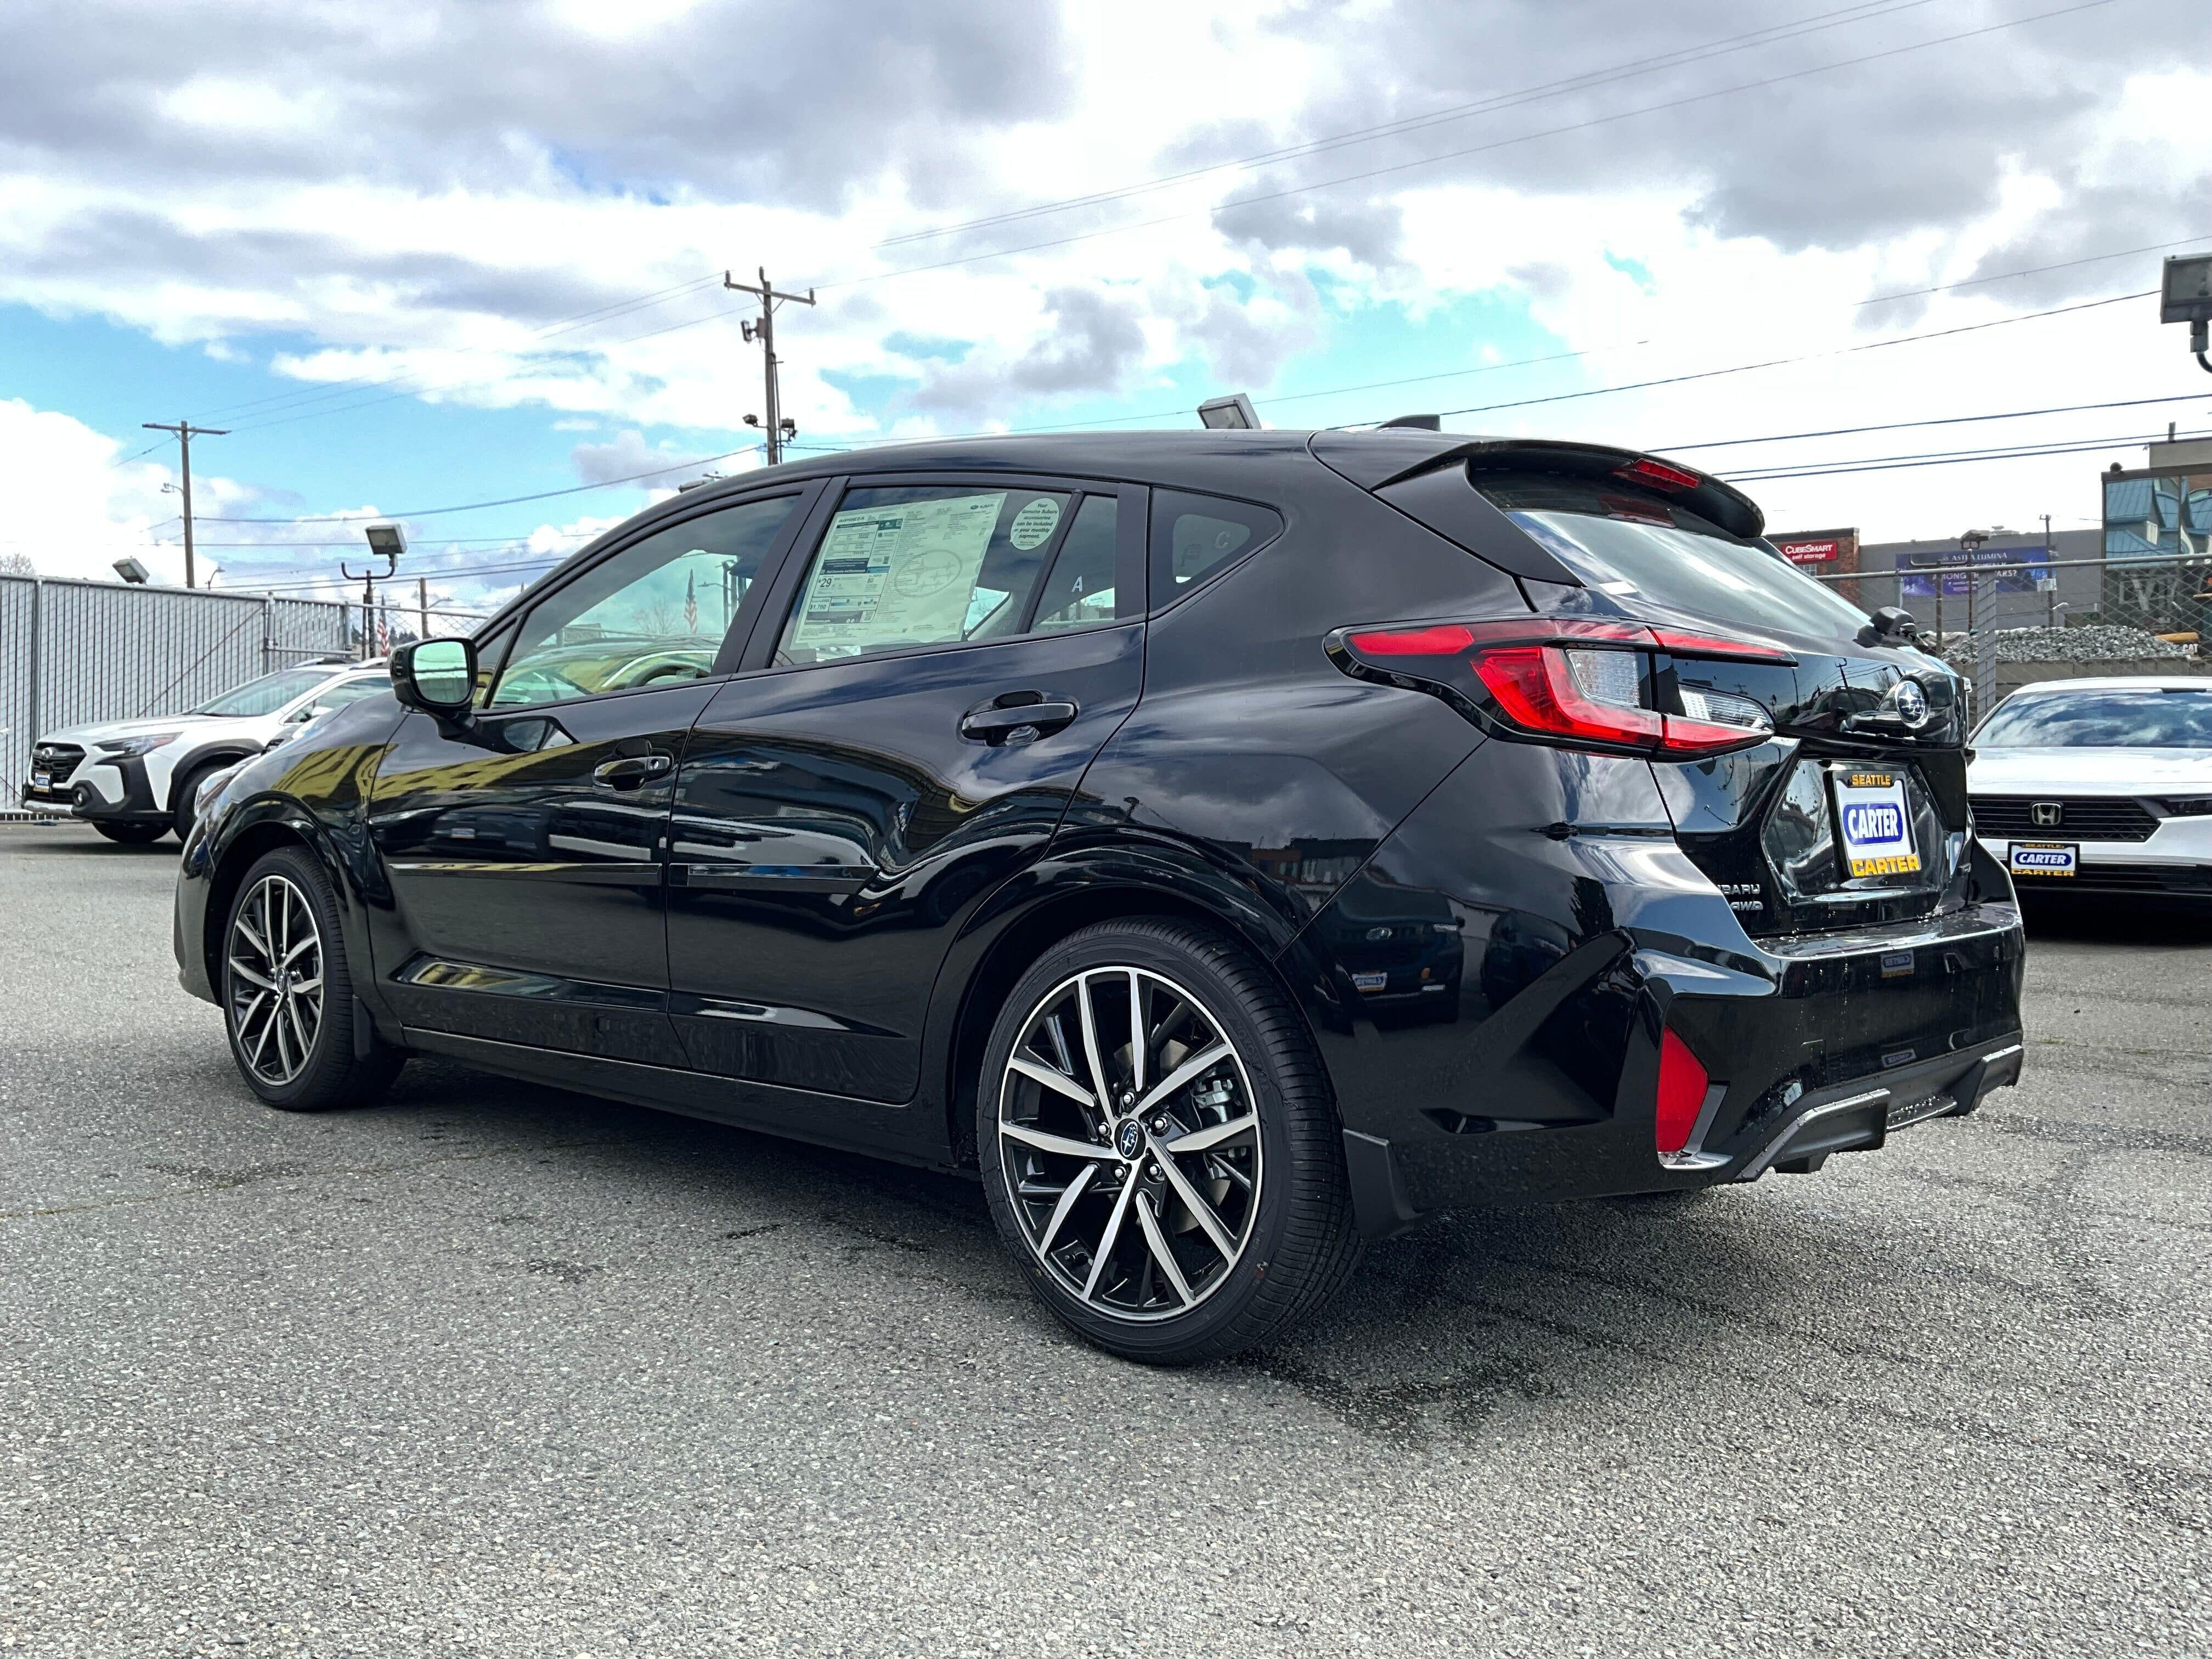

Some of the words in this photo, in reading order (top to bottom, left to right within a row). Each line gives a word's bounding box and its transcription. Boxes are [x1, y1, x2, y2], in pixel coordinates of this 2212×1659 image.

[1977, 552, 2007, 560] LUMINA
[820, 578, 832, 588] 29
[1071, 575, 1083, 592] A
[1852, 774, 1891, 786] SEATTLE
[1848, 808, 1899, 839] CARTER
[2019, 853, 2067, 864] CARTER
[1851, 855, 1920, 877] CARTER
[2011, 868, 2074, 877] CARTER
[1717, 884, 1760, 895] BARU
